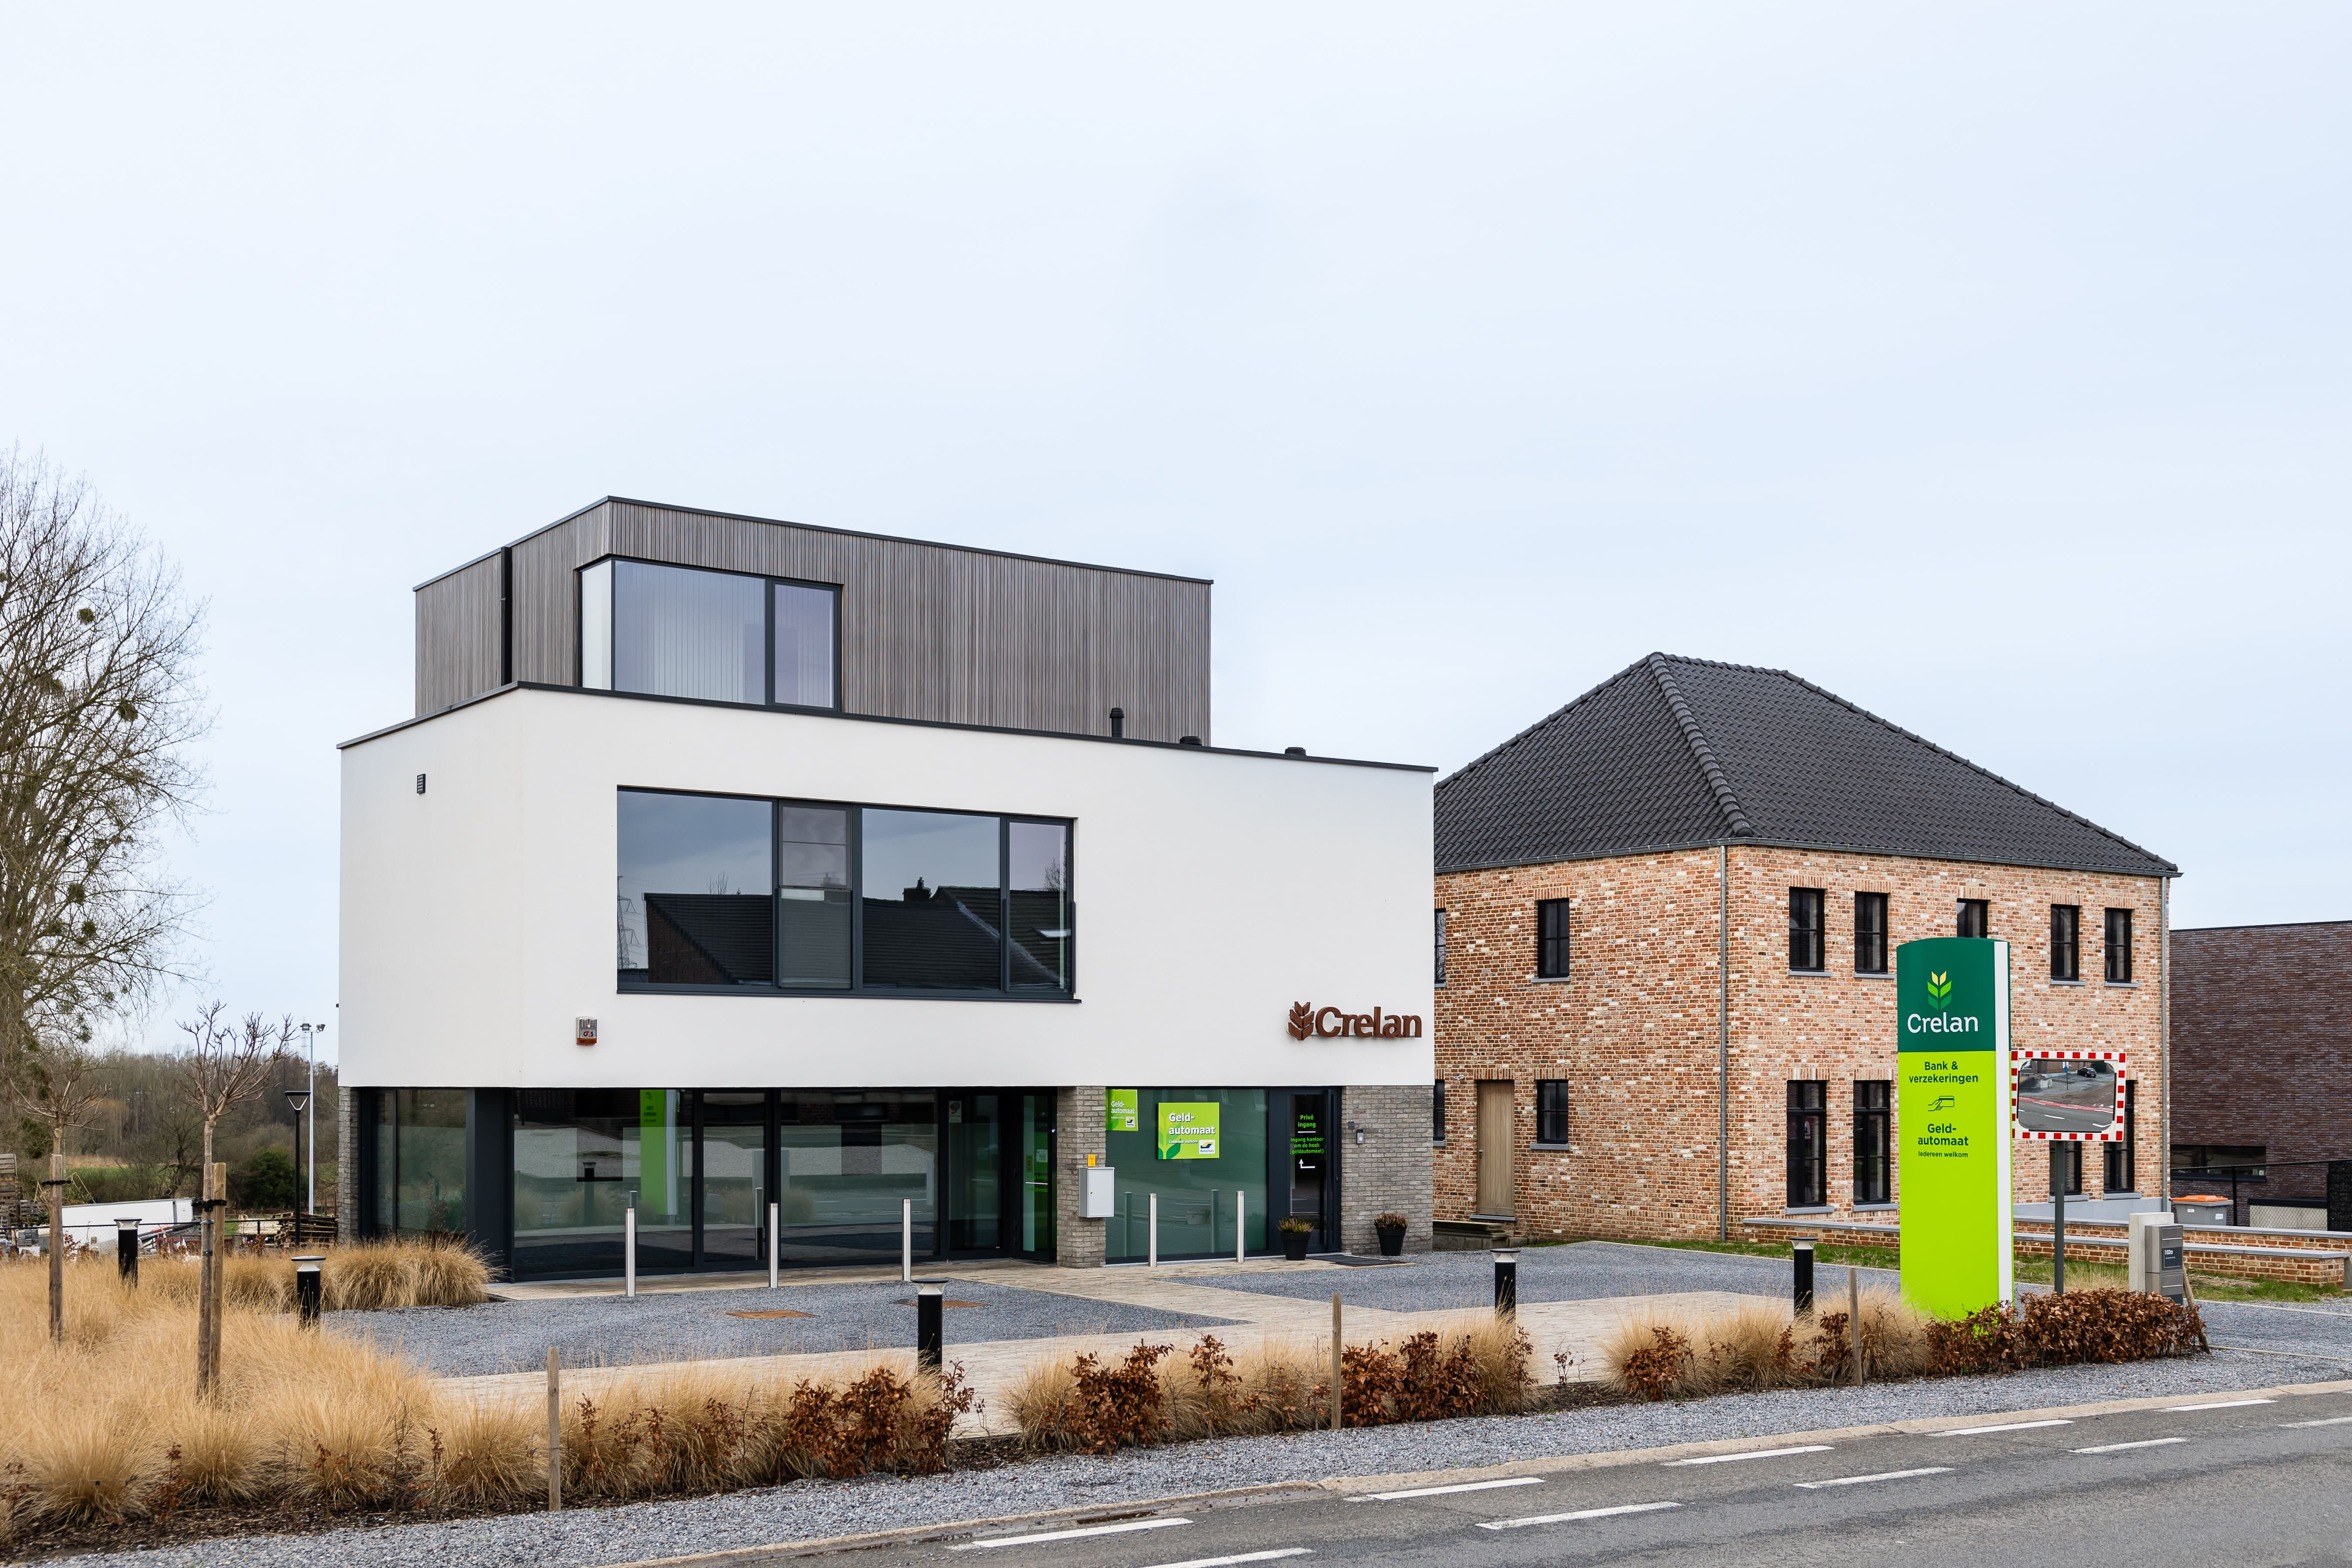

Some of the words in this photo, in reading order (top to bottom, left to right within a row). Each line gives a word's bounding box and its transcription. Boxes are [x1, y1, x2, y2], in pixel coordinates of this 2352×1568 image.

[1315, 1006, 1422, 1038] Crelan
[1907, 1012, 1979, 1034] Crelan
[1924, 1061, 1948, 1070] Bank
[1951, 1061, 1958, 1070] &
[1909, 1074, 1979, 1085] verzekeringen
[1168, 1112, 1195, 1122] Geld-
[1168, 1125, 1216, 1135] automaat
[1927, 1123, 1957, 1133] Geld-
[1918, 1136, 1969, 1146] automaat
